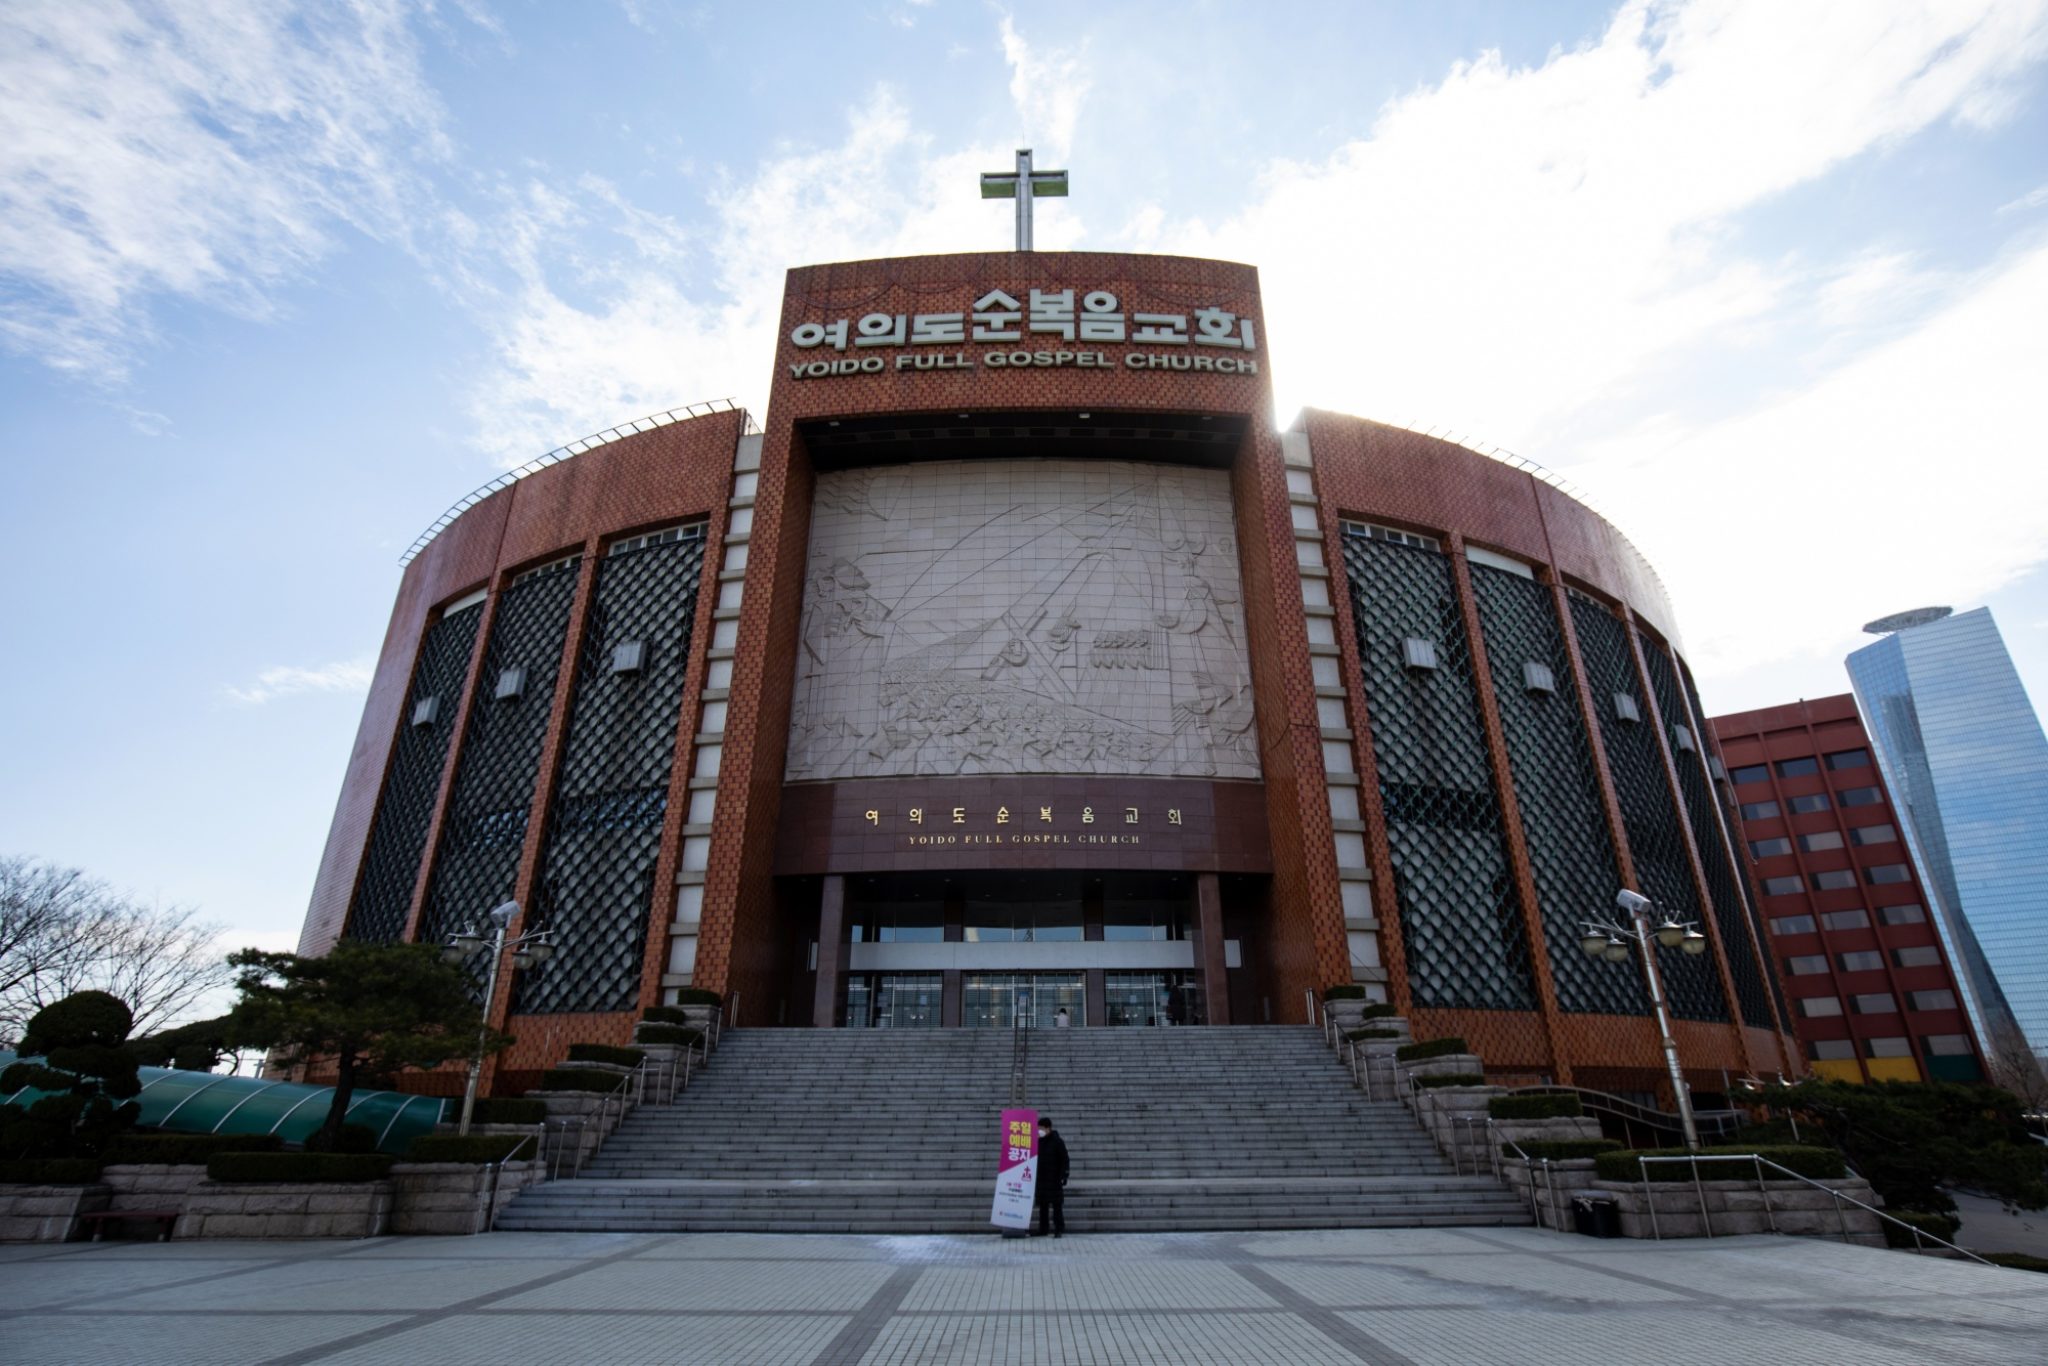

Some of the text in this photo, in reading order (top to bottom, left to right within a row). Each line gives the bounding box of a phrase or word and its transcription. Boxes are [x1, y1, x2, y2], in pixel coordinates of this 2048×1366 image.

[790, 288, 1256, 350] 여의도순복음교회
[790, 351, 1258, 378] YOIDO FULL GOSPEL CHURCH
[909, 835, 1140, 845] YOIDO FULL GOSPEL CHURCH
[1009, 1121, 1031, 1135] 주일
[1009, 1135, 1031, 1148] 예배
[1008, 1147, 1030, 1161] 공지
